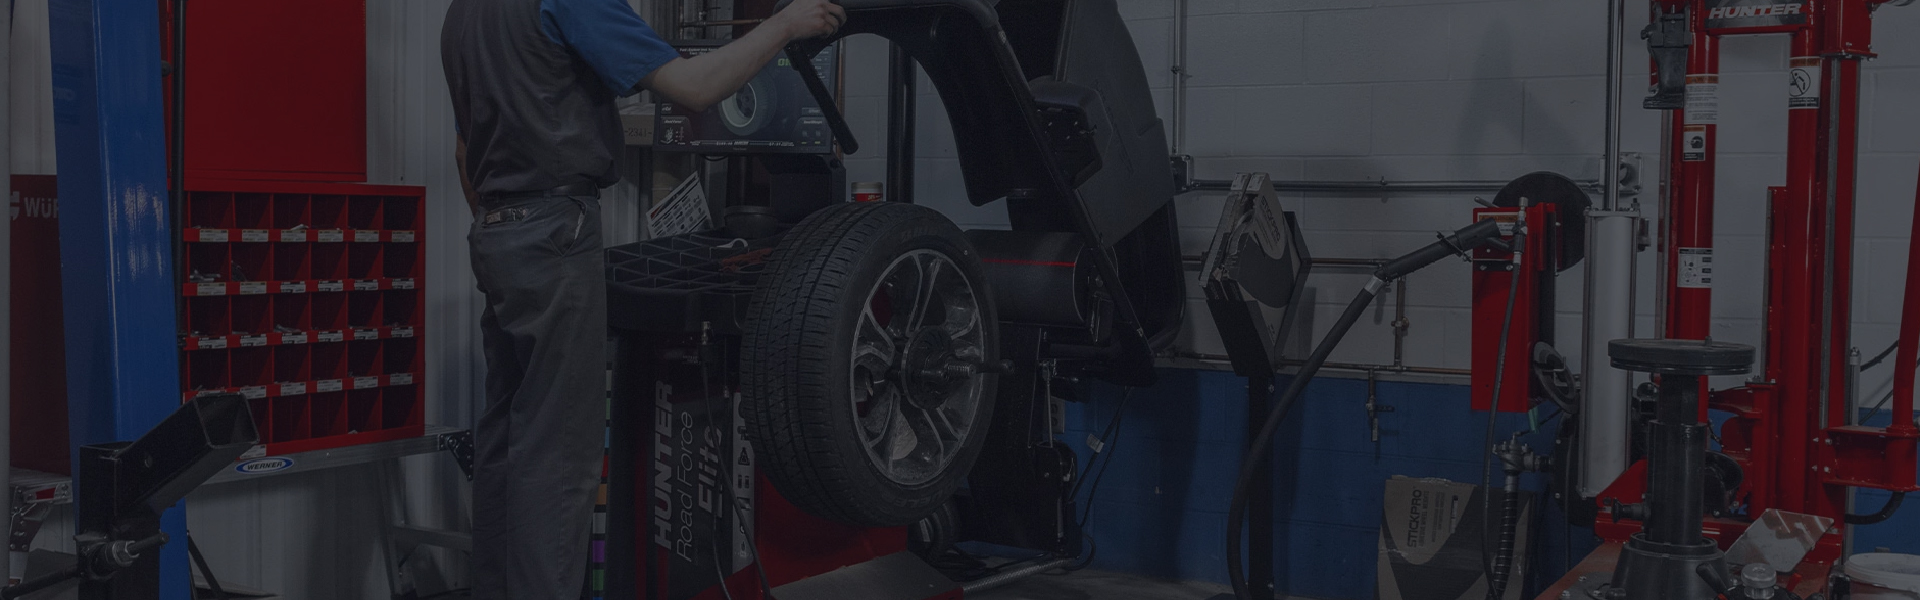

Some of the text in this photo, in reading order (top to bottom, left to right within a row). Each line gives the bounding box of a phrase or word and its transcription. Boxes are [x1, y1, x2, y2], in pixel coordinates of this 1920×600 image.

[1708, 3, 1802, 20] HUNTER
[247, 461, 283, 471] WERNER
[655, 379, 672, 551] HUNTER
[677, 411, 693, 563] Road Force
[698, 424, 722, 518] Elite
[1407, 489, 1422, 548] STICKPRO
